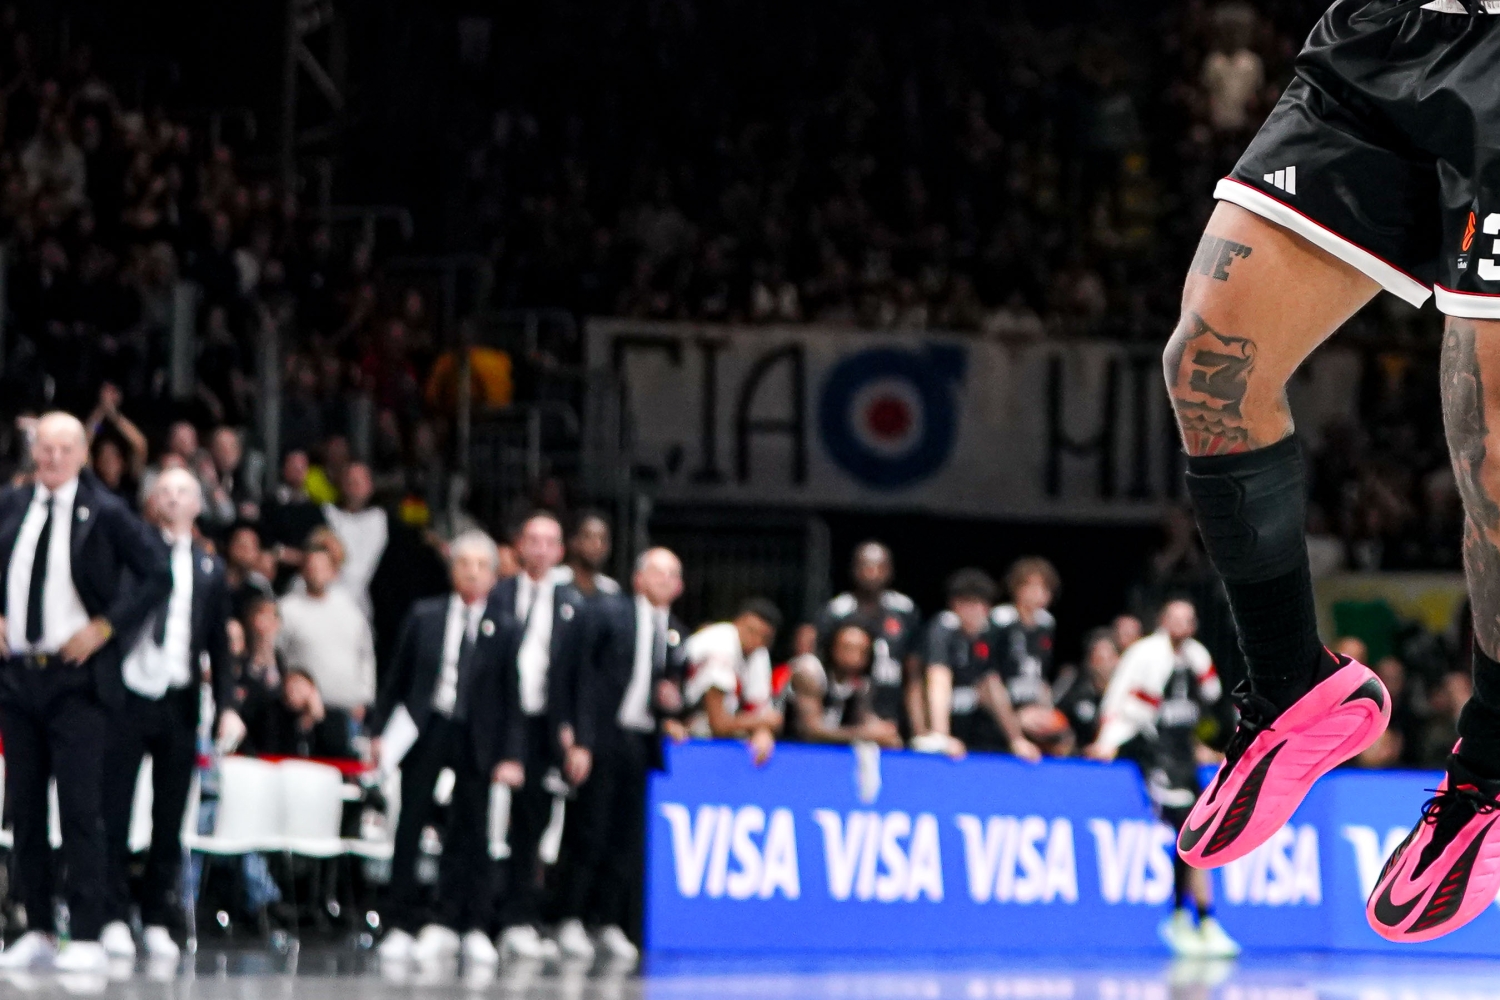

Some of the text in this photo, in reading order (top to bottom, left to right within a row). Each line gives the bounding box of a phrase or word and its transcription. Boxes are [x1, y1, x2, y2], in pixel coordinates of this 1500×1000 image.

[663, 804, 800, 899] VISA
[814, 809, 943, 902] VISA
[957, 813, 1079, 903] VISA
[1090, 818, 1176, 904] VIS
